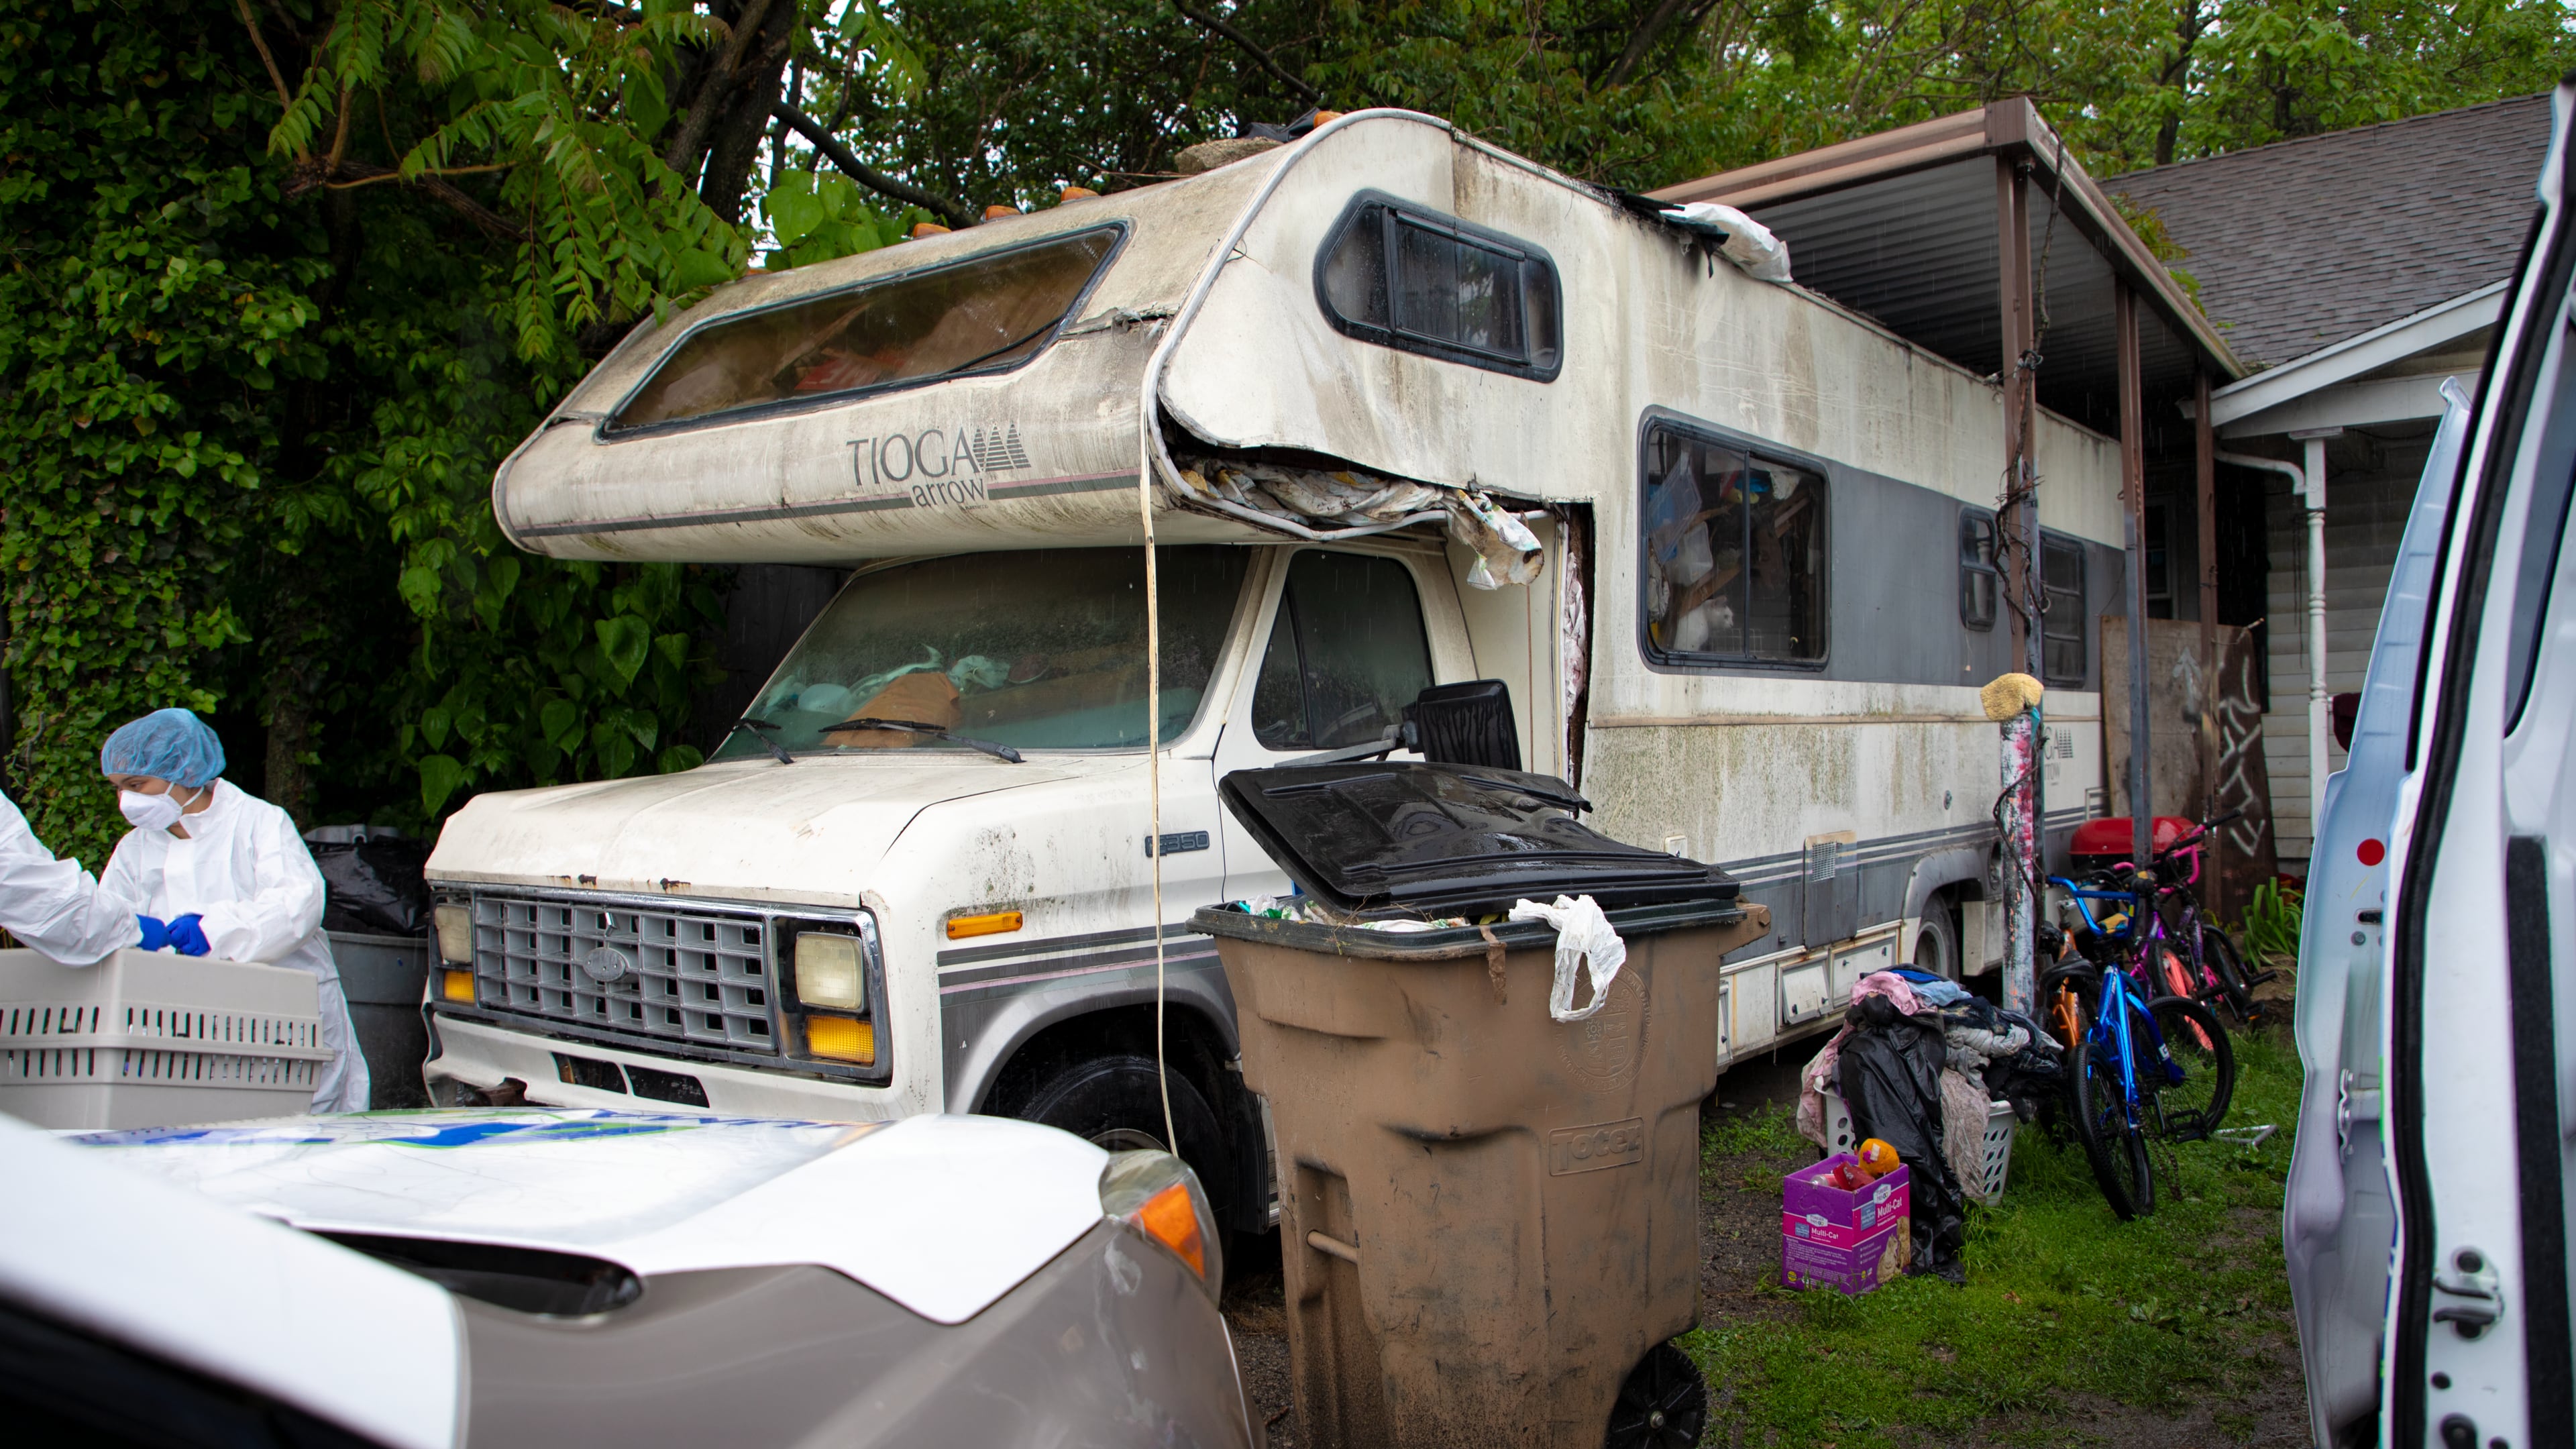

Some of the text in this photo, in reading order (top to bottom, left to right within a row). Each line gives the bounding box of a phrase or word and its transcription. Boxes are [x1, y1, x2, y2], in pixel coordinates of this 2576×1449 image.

[846, 427, 980, 486] TIOGA
[912, 478, 985, 508] arrow
[1551, 1124, 1642, 1172] Toter
[1877, 1196, 1902, 1218] Multi-Cat
[1811, 1227, 1839, 1240] Multi-Cat
